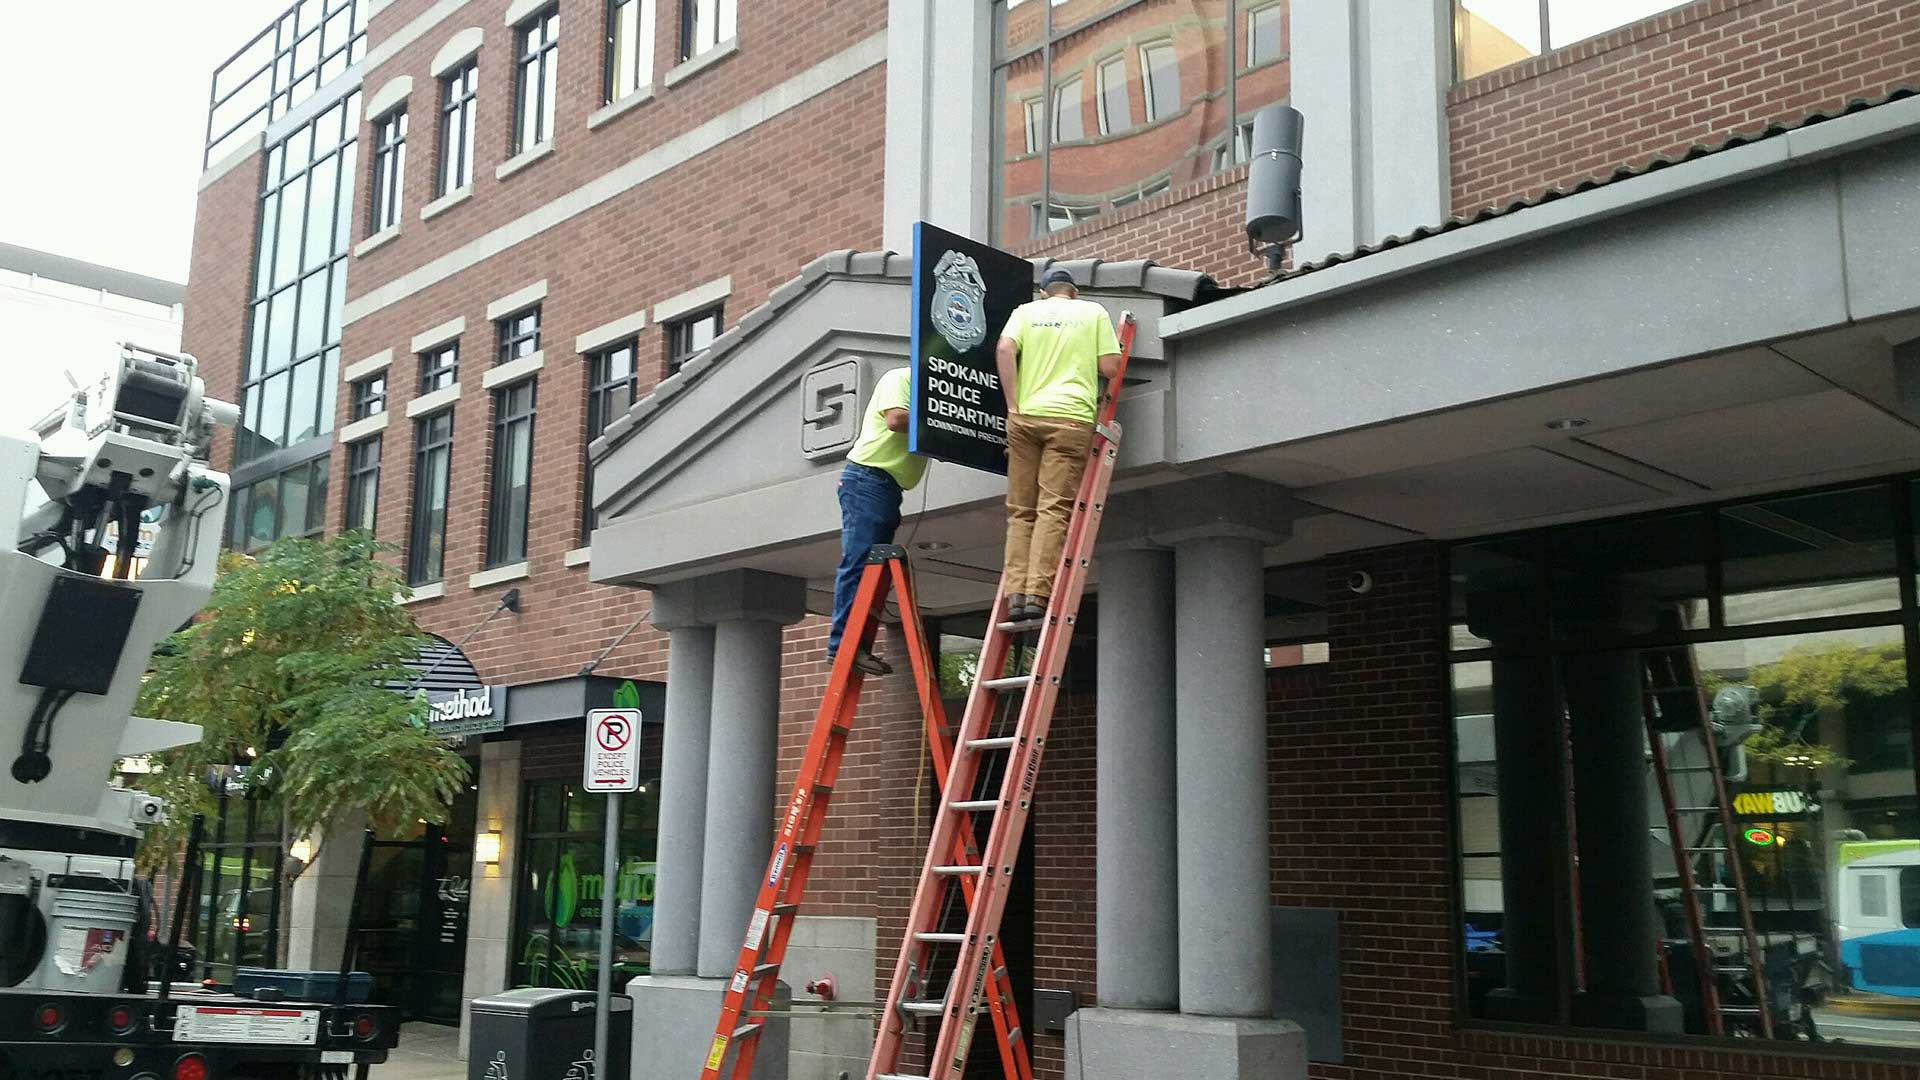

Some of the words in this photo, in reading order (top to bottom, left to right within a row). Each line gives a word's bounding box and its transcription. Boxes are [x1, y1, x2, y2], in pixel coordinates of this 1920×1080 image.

[928, 356, 999, 390] SPOKANE
[928, 376, 981, 405] POLICE
[927, 397, 1008, 431] DEPARTME
[926, 417, 977, 438] DOWNTOWN
[977, 430, 1009, 446] PRECIN
[597, 752, 627, 760] EXCEPT
[597, 760, 625, 768] POLICE
[593, 768, 631, 776] VEHICLES
